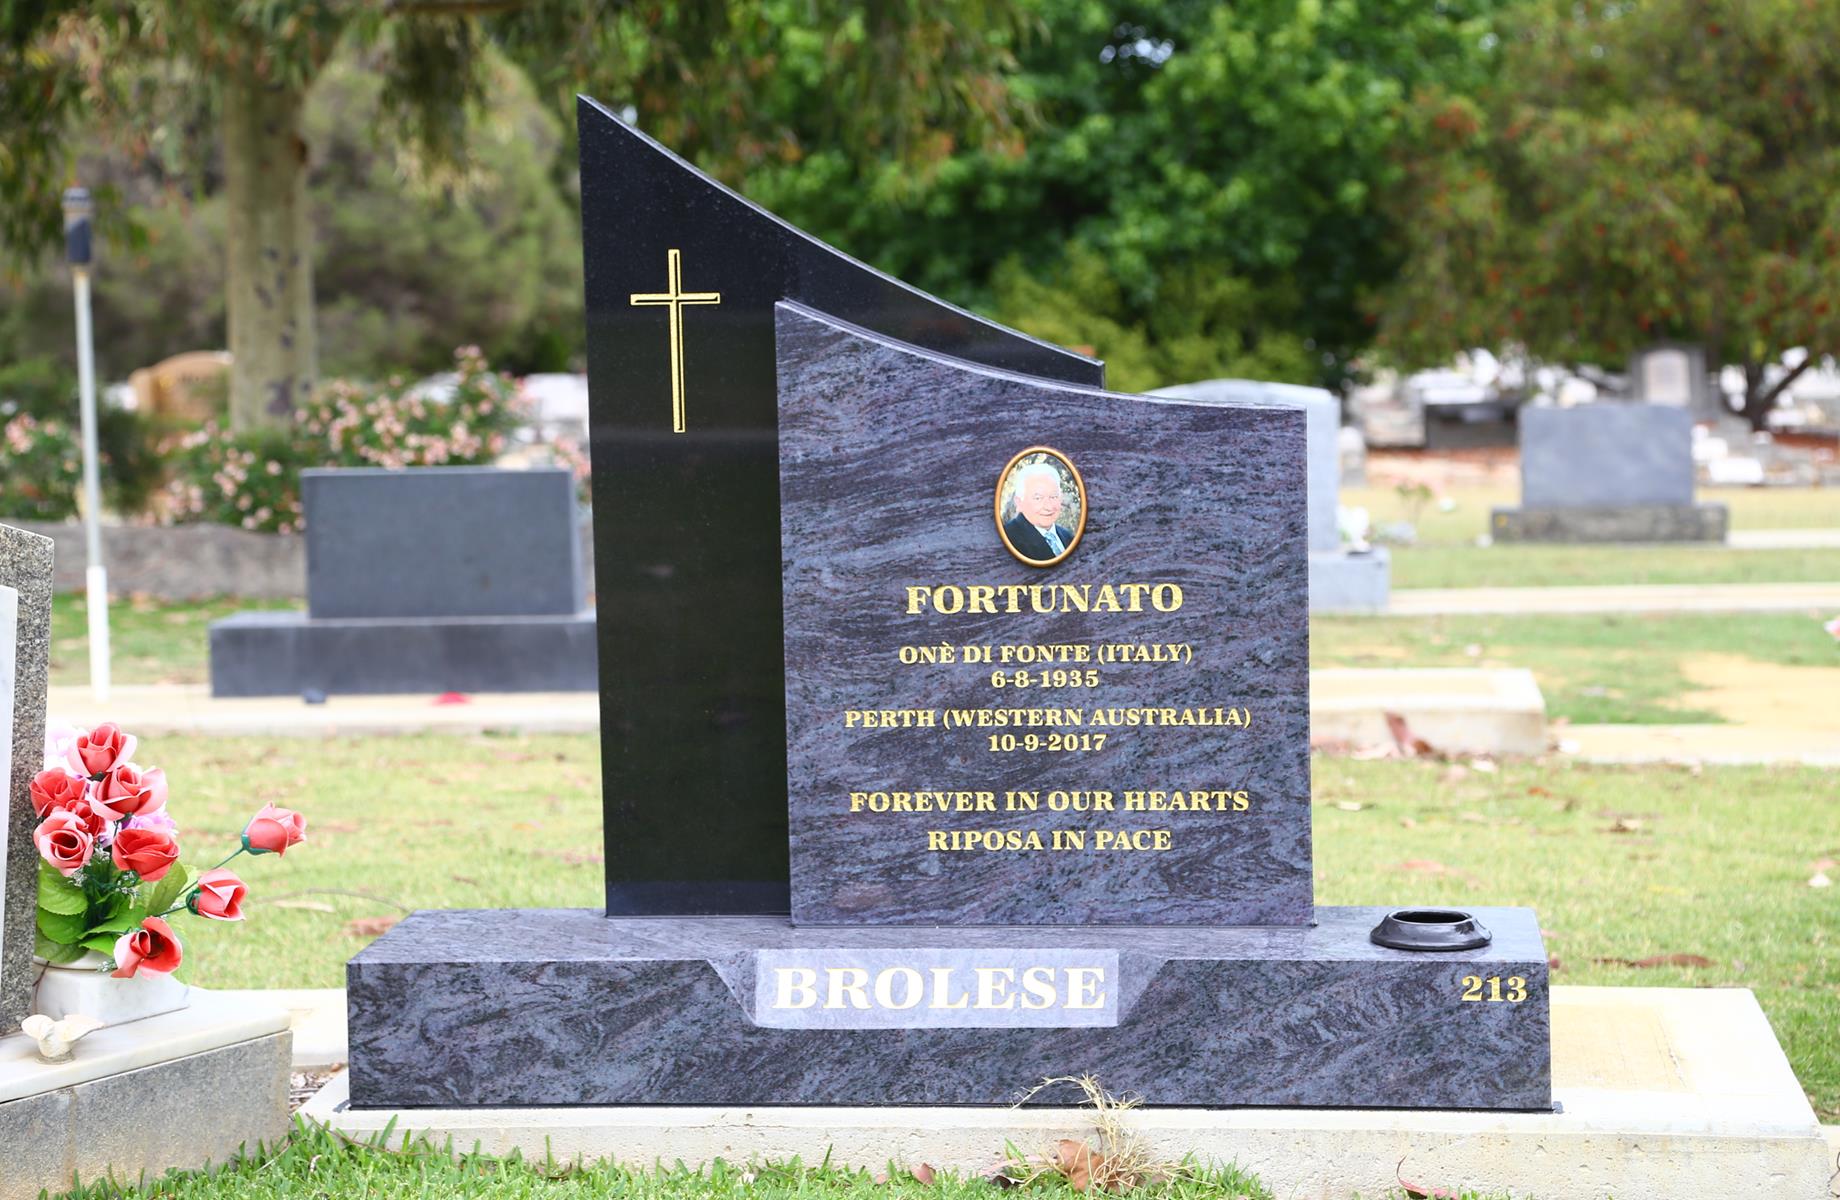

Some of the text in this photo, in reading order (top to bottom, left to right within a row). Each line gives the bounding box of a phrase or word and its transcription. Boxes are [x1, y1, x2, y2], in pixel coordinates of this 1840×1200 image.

[907, 583, 1184, 614] FORTUNATO
[899, 642, 1192, 664] ONÈ DI FONTE (ITALY)
[991, 669, 1099, 688] 6-8-1935
[845, 707, 1251, 728] PERTH (WESTERN AUSTRALIA)
[989, 733, 1106, 751] 10-9-2017
[850, 790, 1249, 812] FOREVER IN OUR HEARTS
[928, 830, 1171, 851] RIPOSA IN PACE
[772, 968, 1104, 1009] BROLESE
[1462, 976, 1527, 1001] 213
